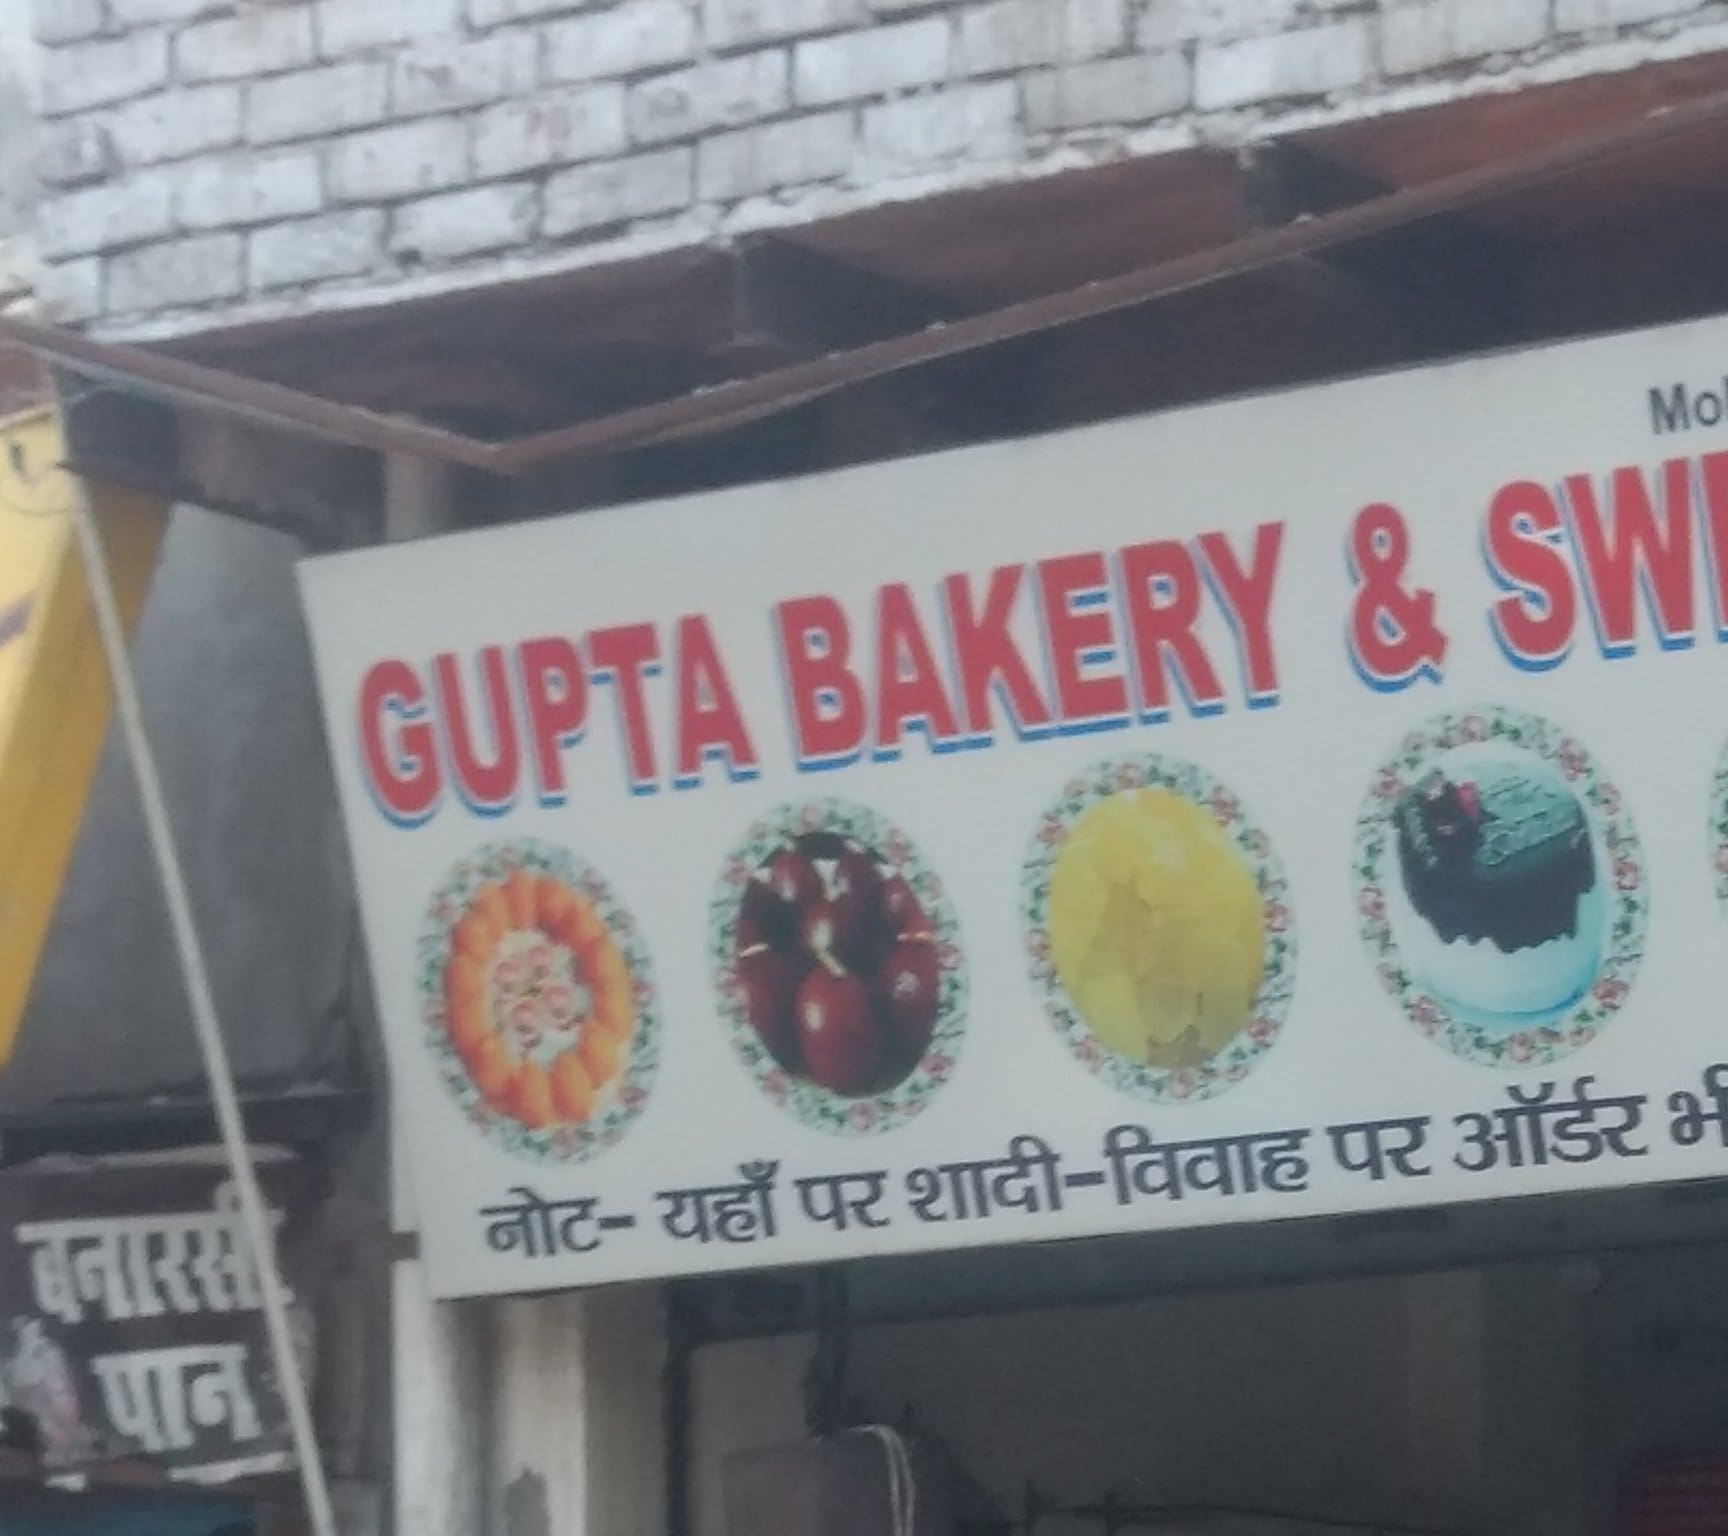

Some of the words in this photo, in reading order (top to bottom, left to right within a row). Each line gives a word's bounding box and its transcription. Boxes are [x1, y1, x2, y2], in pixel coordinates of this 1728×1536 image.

[356, 612, 760, 829] GUPTA
[772, 521, 1285, 773] BAKERY
[1346, 500, 1449, 692] &
[659, 1158, 781, 1244] यहाँ
[796, 1170, 890, 1236] पर
[909, 1122, 1310, 1227] शादी-विवाह
[1327, 1113, 1432, 1182] पर
[1452, 1073, 1648, 1176] ऑर्डर
[90, 1343, 262, 1453] पान
